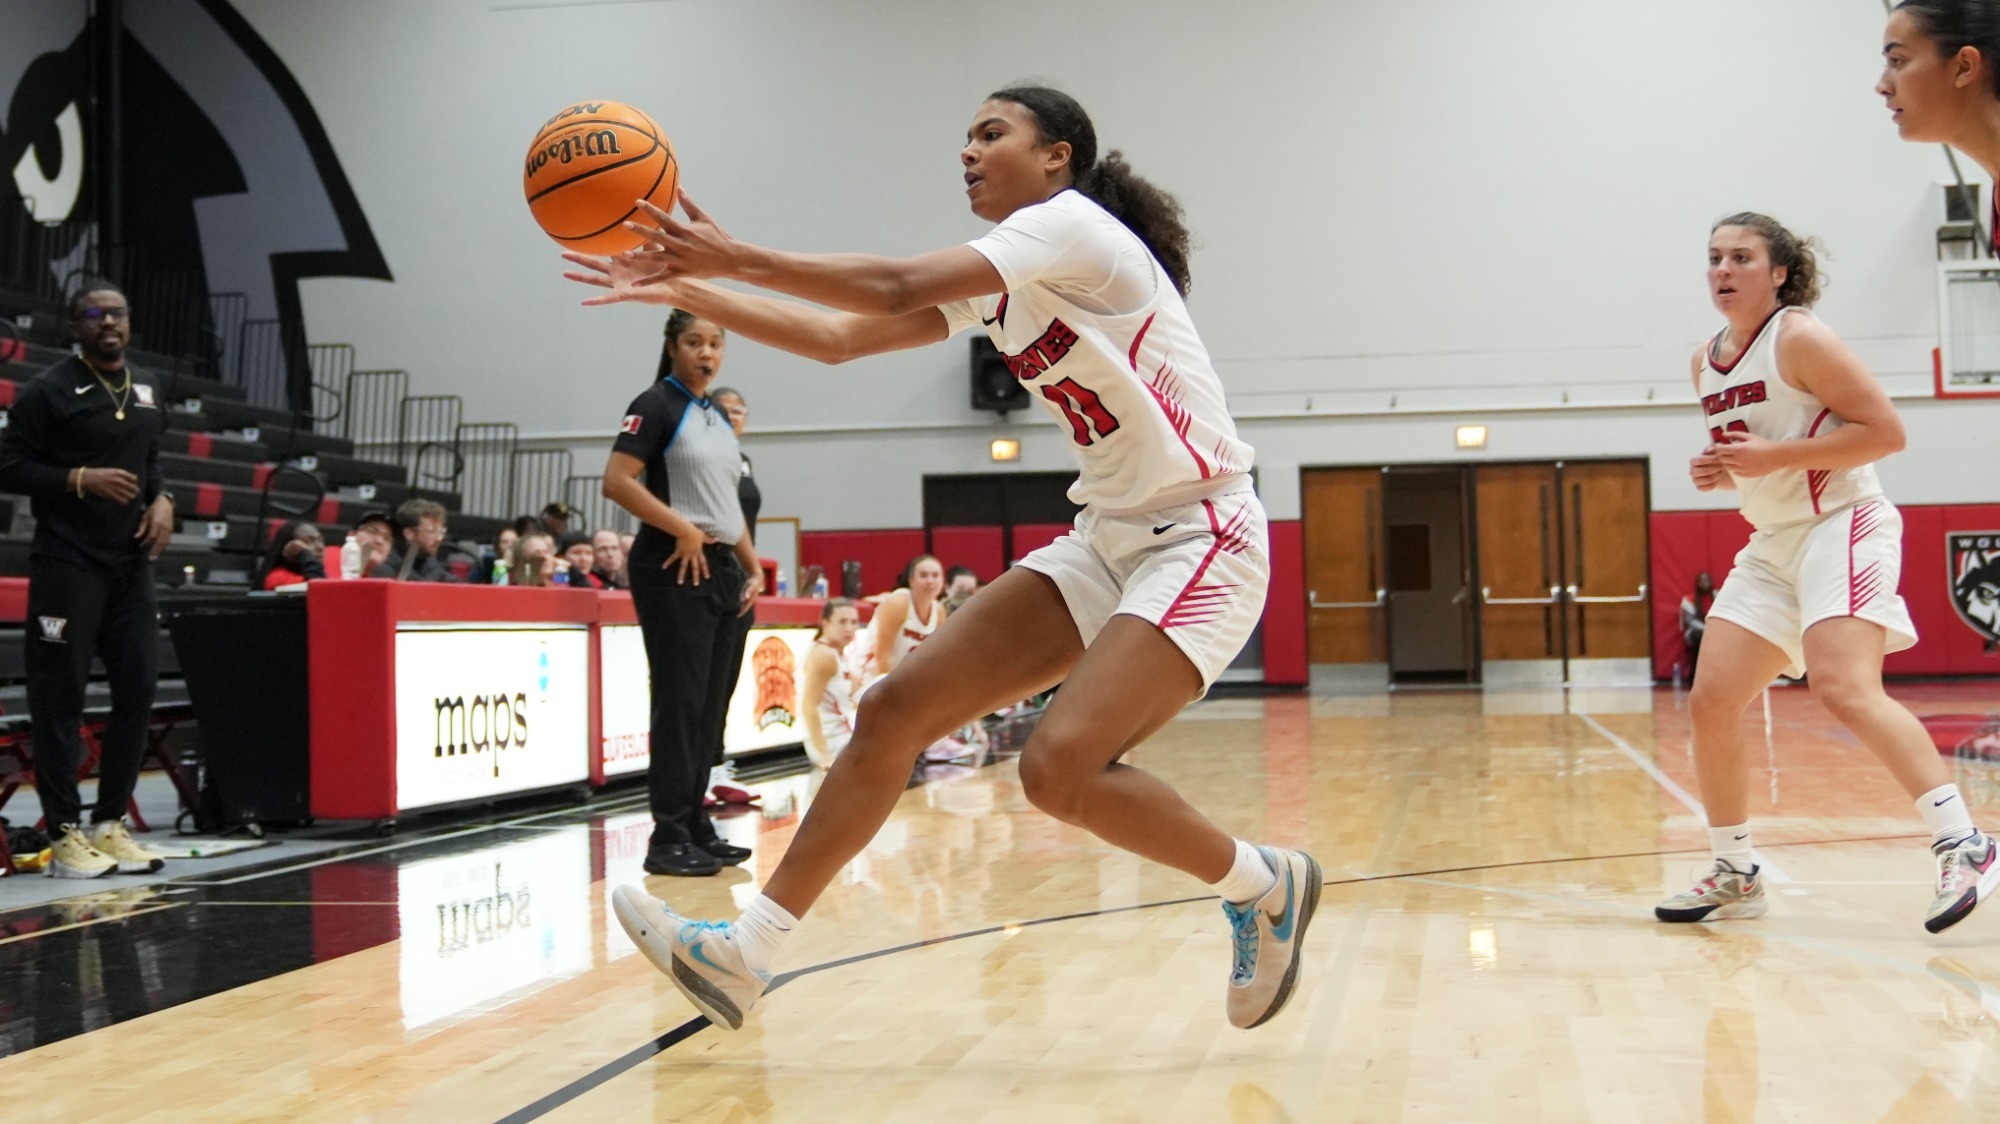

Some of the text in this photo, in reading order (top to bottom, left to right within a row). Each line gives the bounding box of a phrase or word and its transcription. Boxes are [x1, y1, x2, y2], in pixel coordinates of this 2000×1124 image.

[526, 129, 621, 178] Wilson
[1002, 316, 1079, 380] OLVES
[1040, 376, 1120, 446] 11
[434, 692, 528, 778] maps
